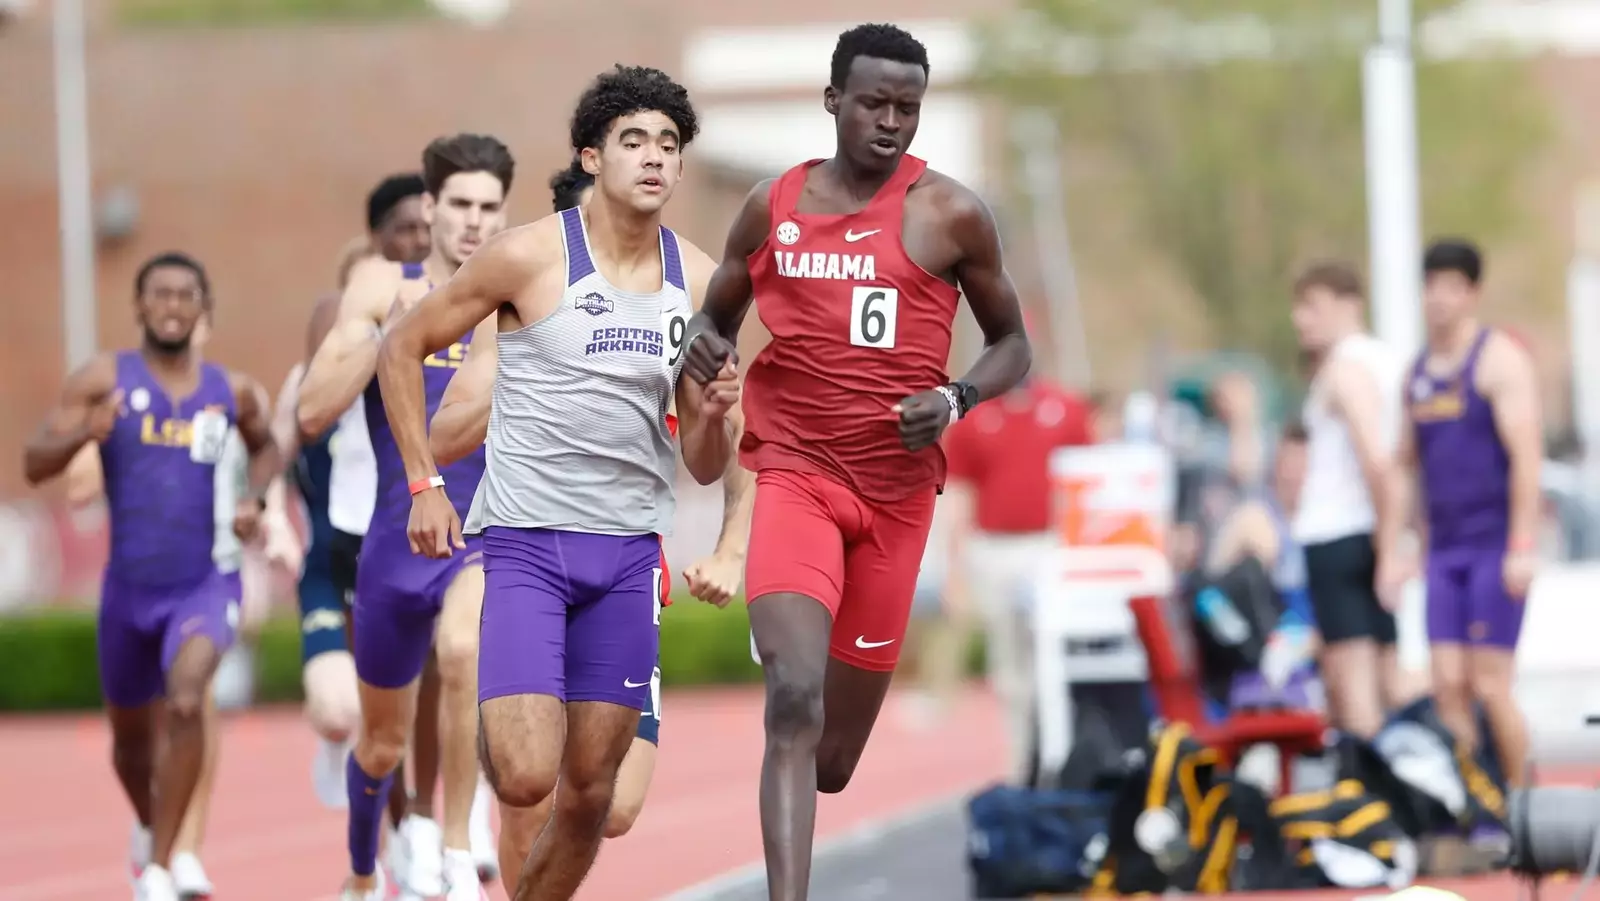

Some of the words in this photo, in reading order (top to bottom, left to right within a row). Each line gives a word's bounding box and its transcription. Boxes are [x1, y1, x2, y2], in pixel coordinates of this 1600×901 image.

[774, 250, 876, 280] ALABAMA
[860, 291, 887, 344] 6
[585, 339, 664, 357] ARKANS
[592, 327, 664, 345] CENTRA
[668, 315, 686, 367] 9
